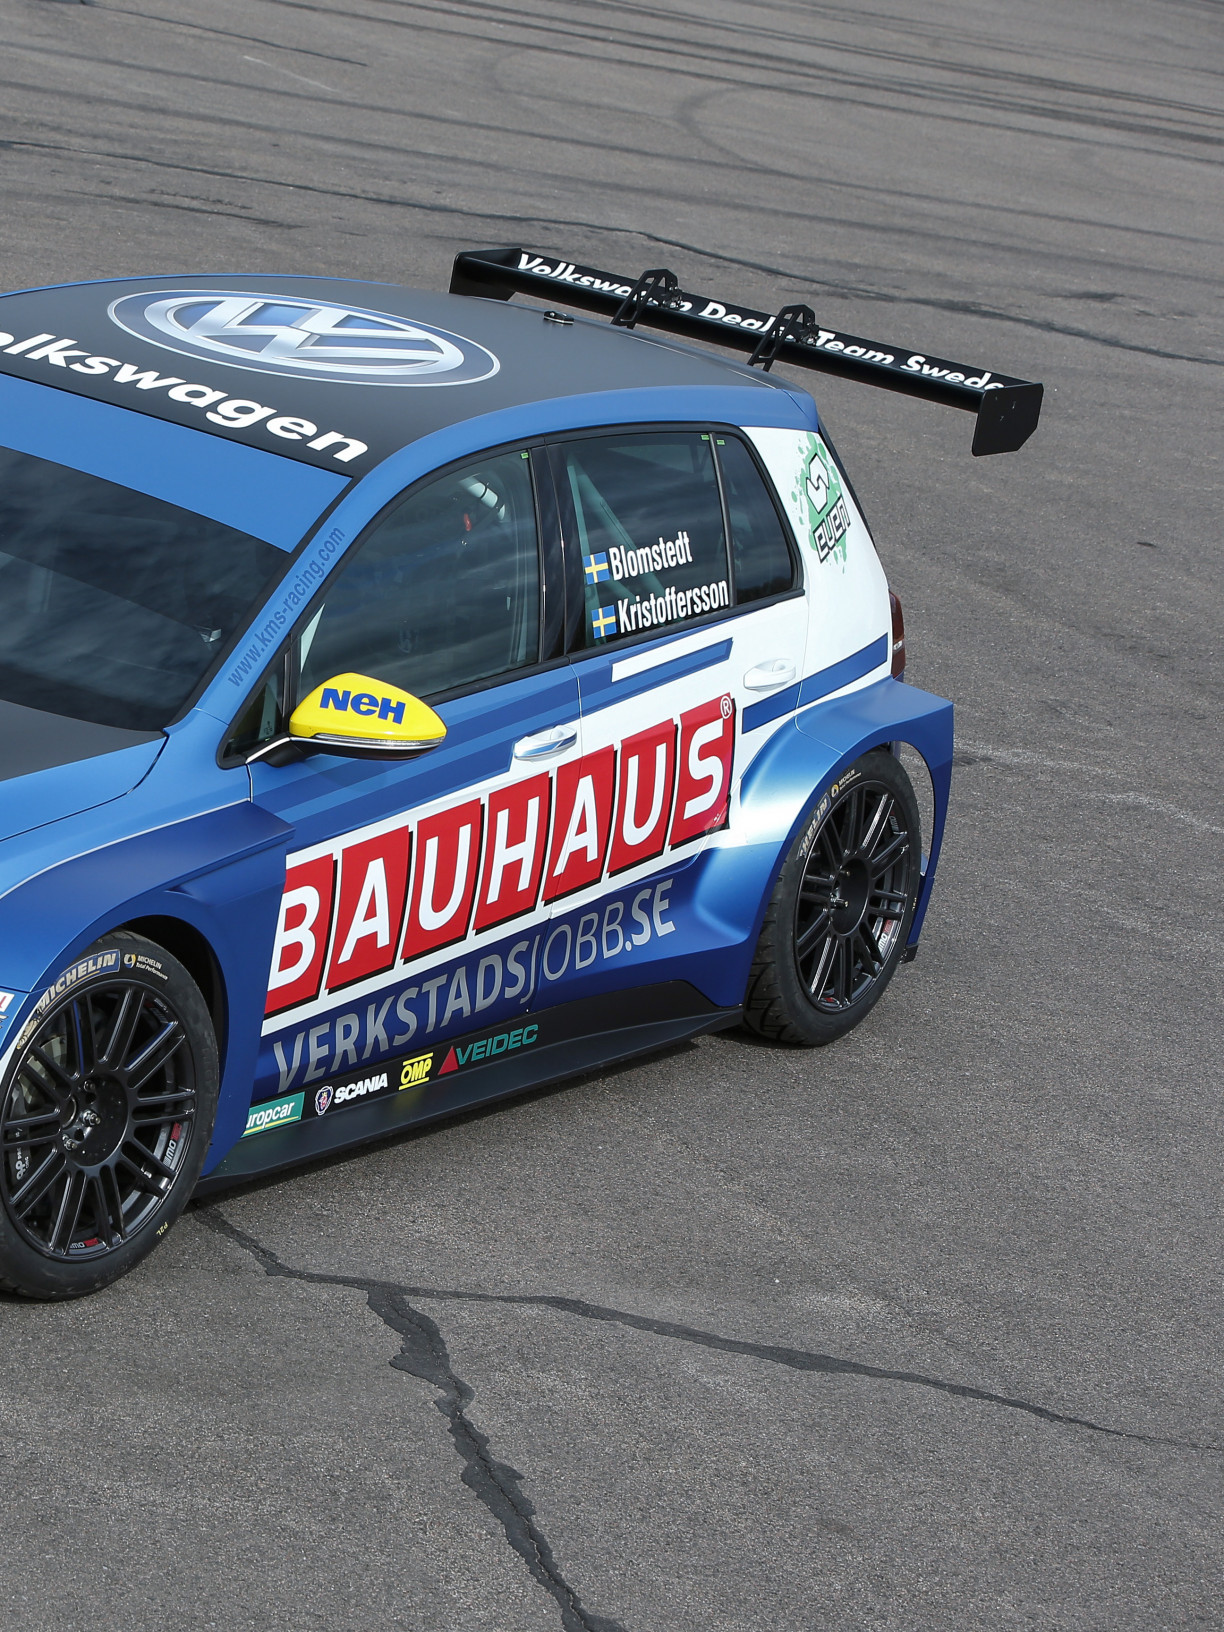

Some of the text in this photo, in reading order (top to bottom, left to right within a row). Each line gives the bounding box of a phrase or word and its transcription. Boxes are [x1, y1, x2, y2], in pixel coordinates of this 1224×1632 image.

[517, 253, 1005, 391] Volkswan Deal Team Swede
[608, 531, 693, 581] Blomstedt
[227, 527, 346, 687] www.kms-racing.com
[617, 580, 729, 634] Kristoffersson
[266, 714, 727, 992] BAUHAUS
[39, 952, 117, 1012] MICHELIN
[137, 955, 163, 970] MICHELIN
[274, 879, 676, 1091] VERKSTADSJOBB.SE
[401, 1057, 432, 1085] OMP
[456, 1025, 539, 1066] VEIDEC
[334, 1073, 388, 1104] SCANIA
